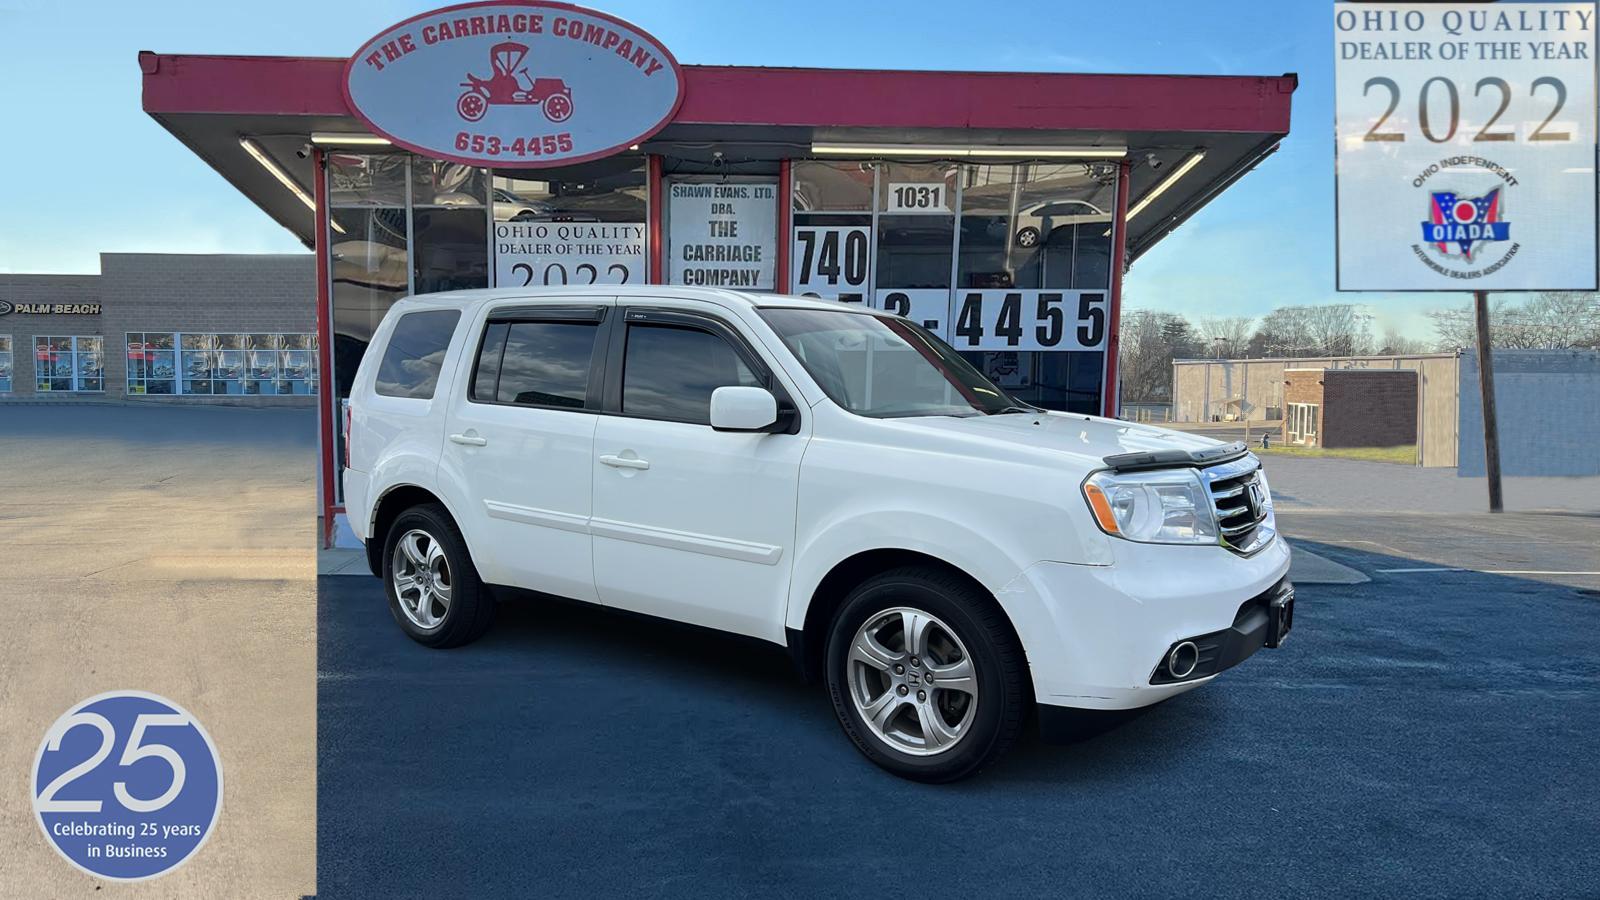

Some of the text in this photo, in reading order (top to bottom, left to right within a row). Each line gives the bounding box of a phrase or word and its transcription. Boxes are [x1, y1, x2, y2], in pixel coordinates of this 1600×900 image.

[1336, 10, 1593, 35] OHIO QUALITY
[366, 14, 664, 77] THE CARRIAGE COMPANY
[1340, 42, 1589, 60] DEALER OF THE YEAR
[1362, 76, 1570, 144] 2022
[455, 132, 573, 156] 653-4455
[1412, 156, 1519, 188] OHIO INDEPENDENT
[673, 186, 711, 198] SHAWN
[754, 187, 774, 199] LTD.
[895, 187, 940, 209] 1031
[711, 203, 736, 215] DBA.
[497, 226, 643, 241] OHIO QUALITY
[709, 221, 738, 237] THE
[1433, 224, 1495, 240] OIADA
[500, 243, 641, 255] DEALER OF THE YEAR
[683, 244, 762, 262] CARRIAGE
[797, 230, 868, 286] 740
[1411, 242, 1520, 279] AUTOMOBILE DEALERS ASSOCIATION
[683, 268, 760, 286] COMPANY
[15, 304, 100, 314] PALM BEACH
